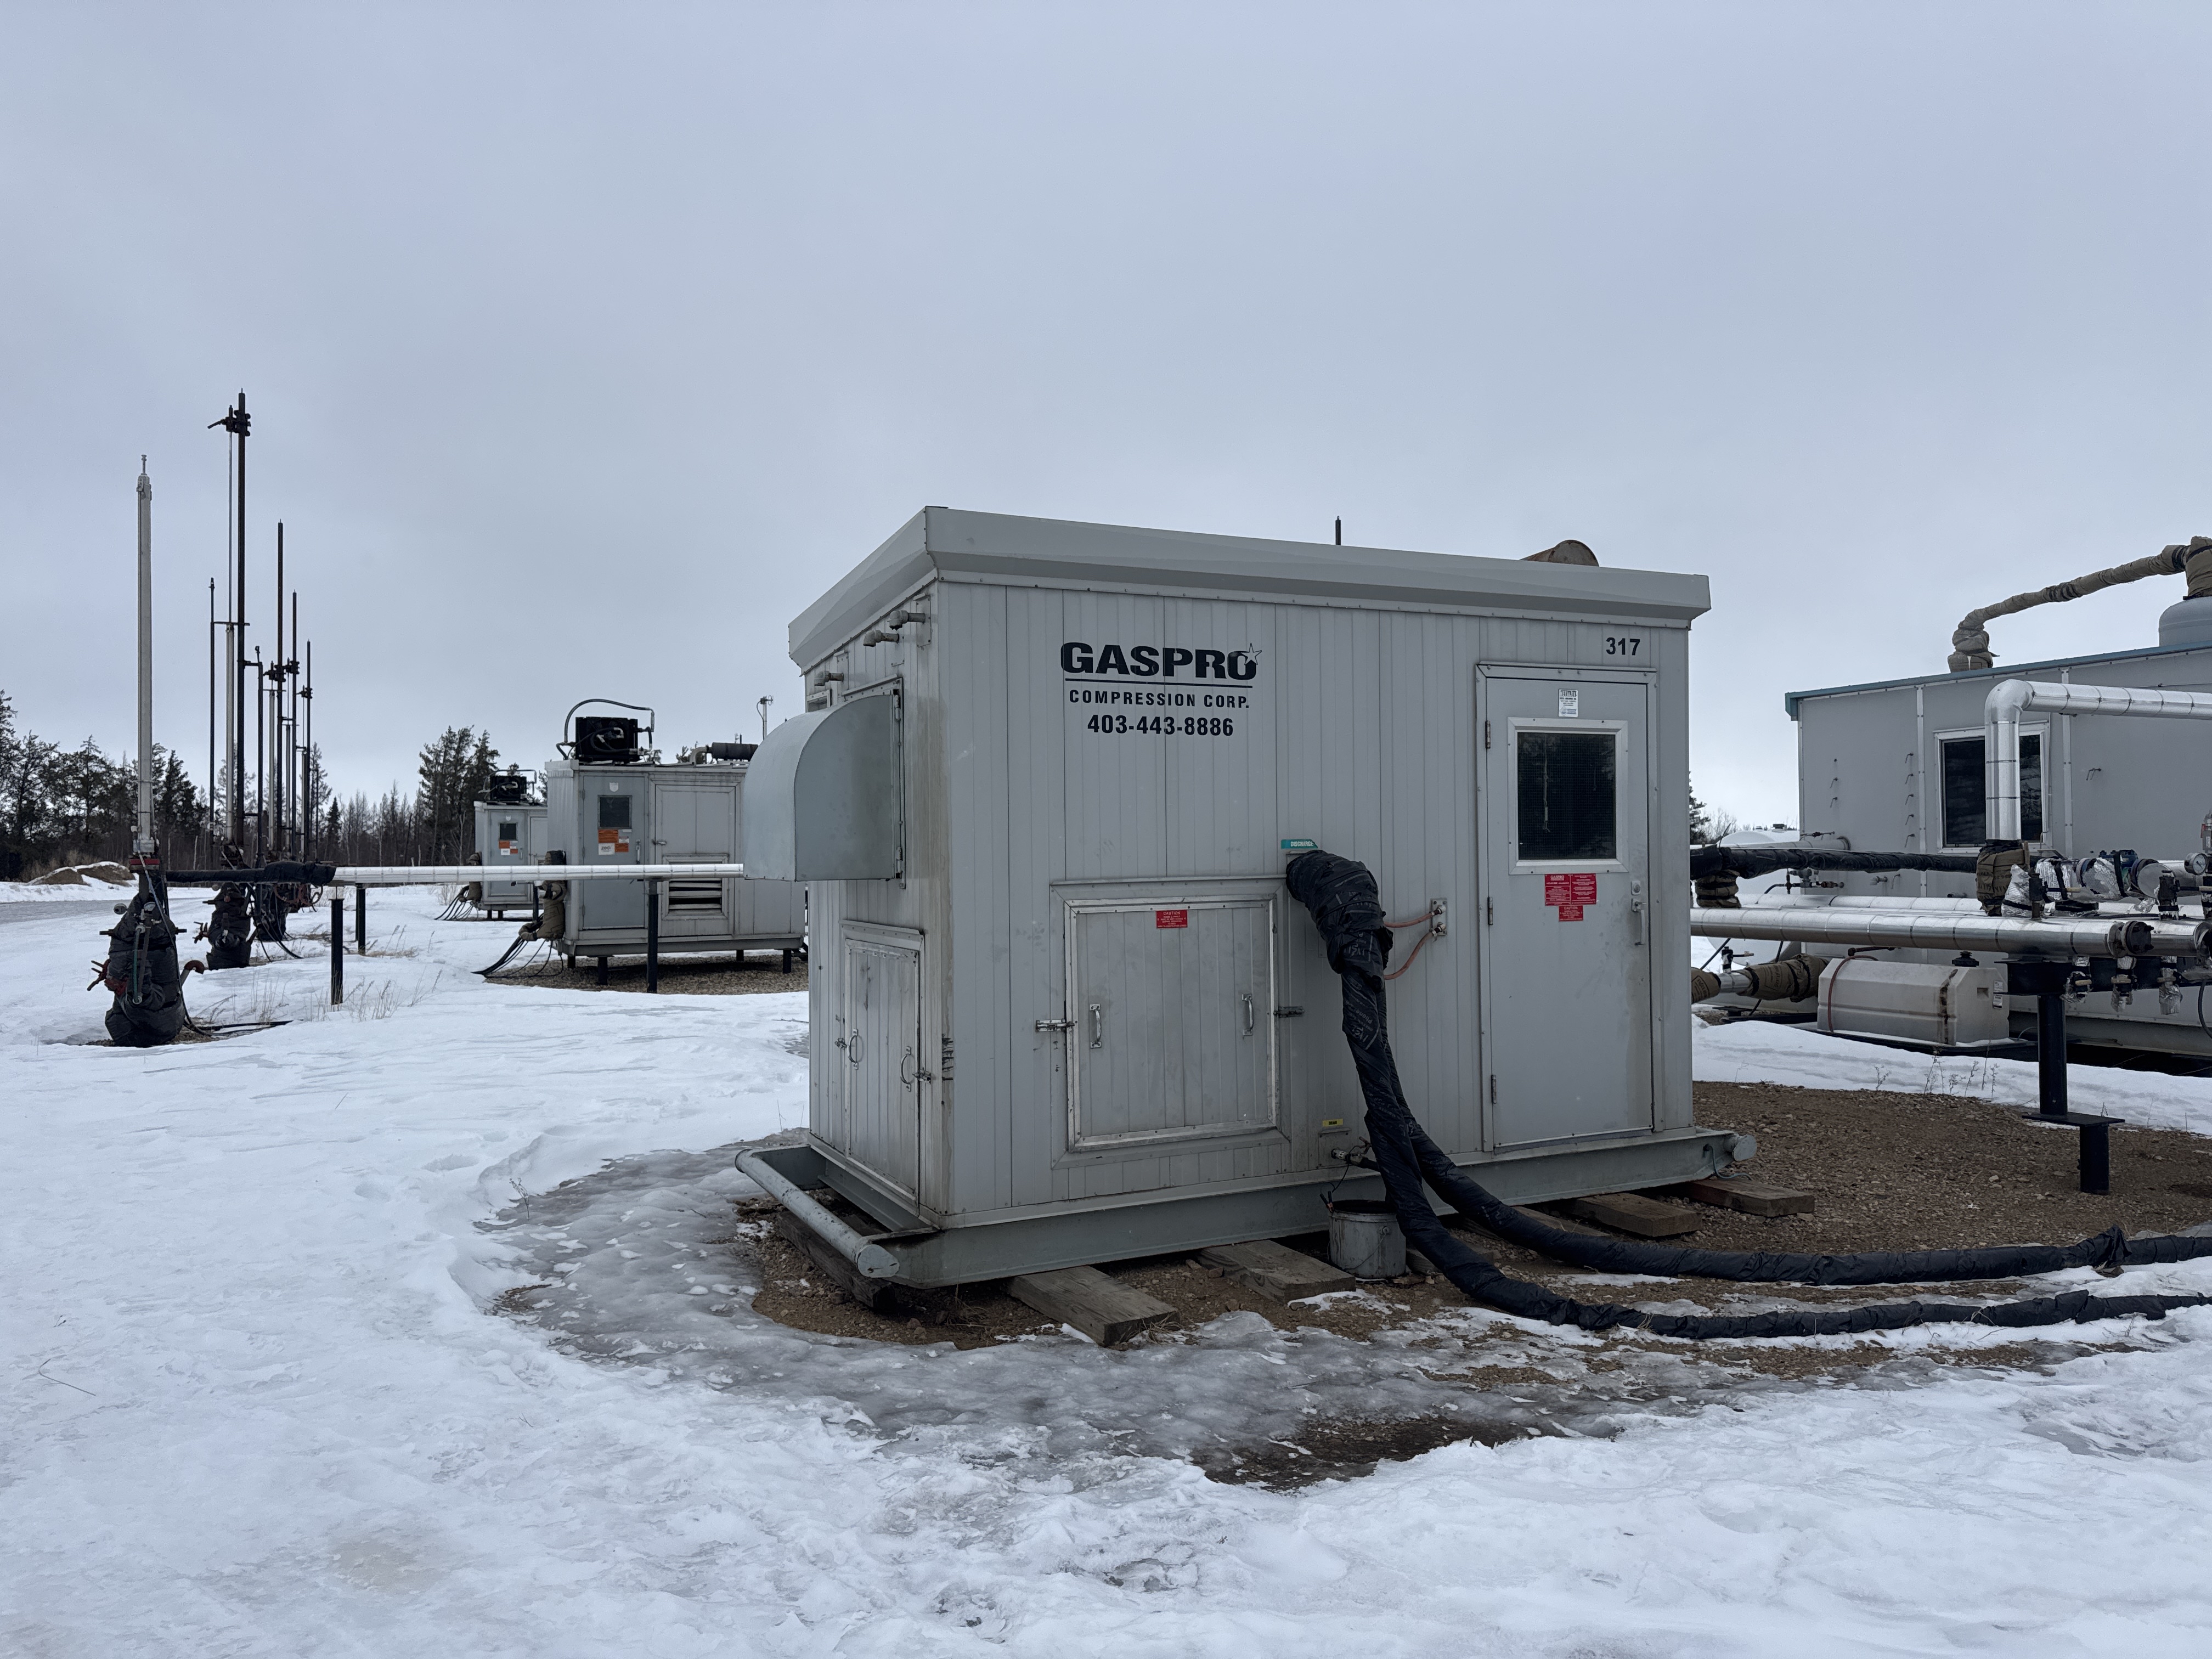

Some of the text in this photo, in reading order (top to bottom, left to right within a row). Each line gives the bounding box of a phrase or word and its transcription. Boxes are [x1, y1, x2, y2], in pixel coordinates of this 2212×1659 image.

[1606, 637, 1640, 656] 317
[1060, 642, 1257, 680] GASPRO
[1069, 690, 1249, 708] COMPRESSION CORP.
[1087, 714, 1233, 736] 403-443-8886
